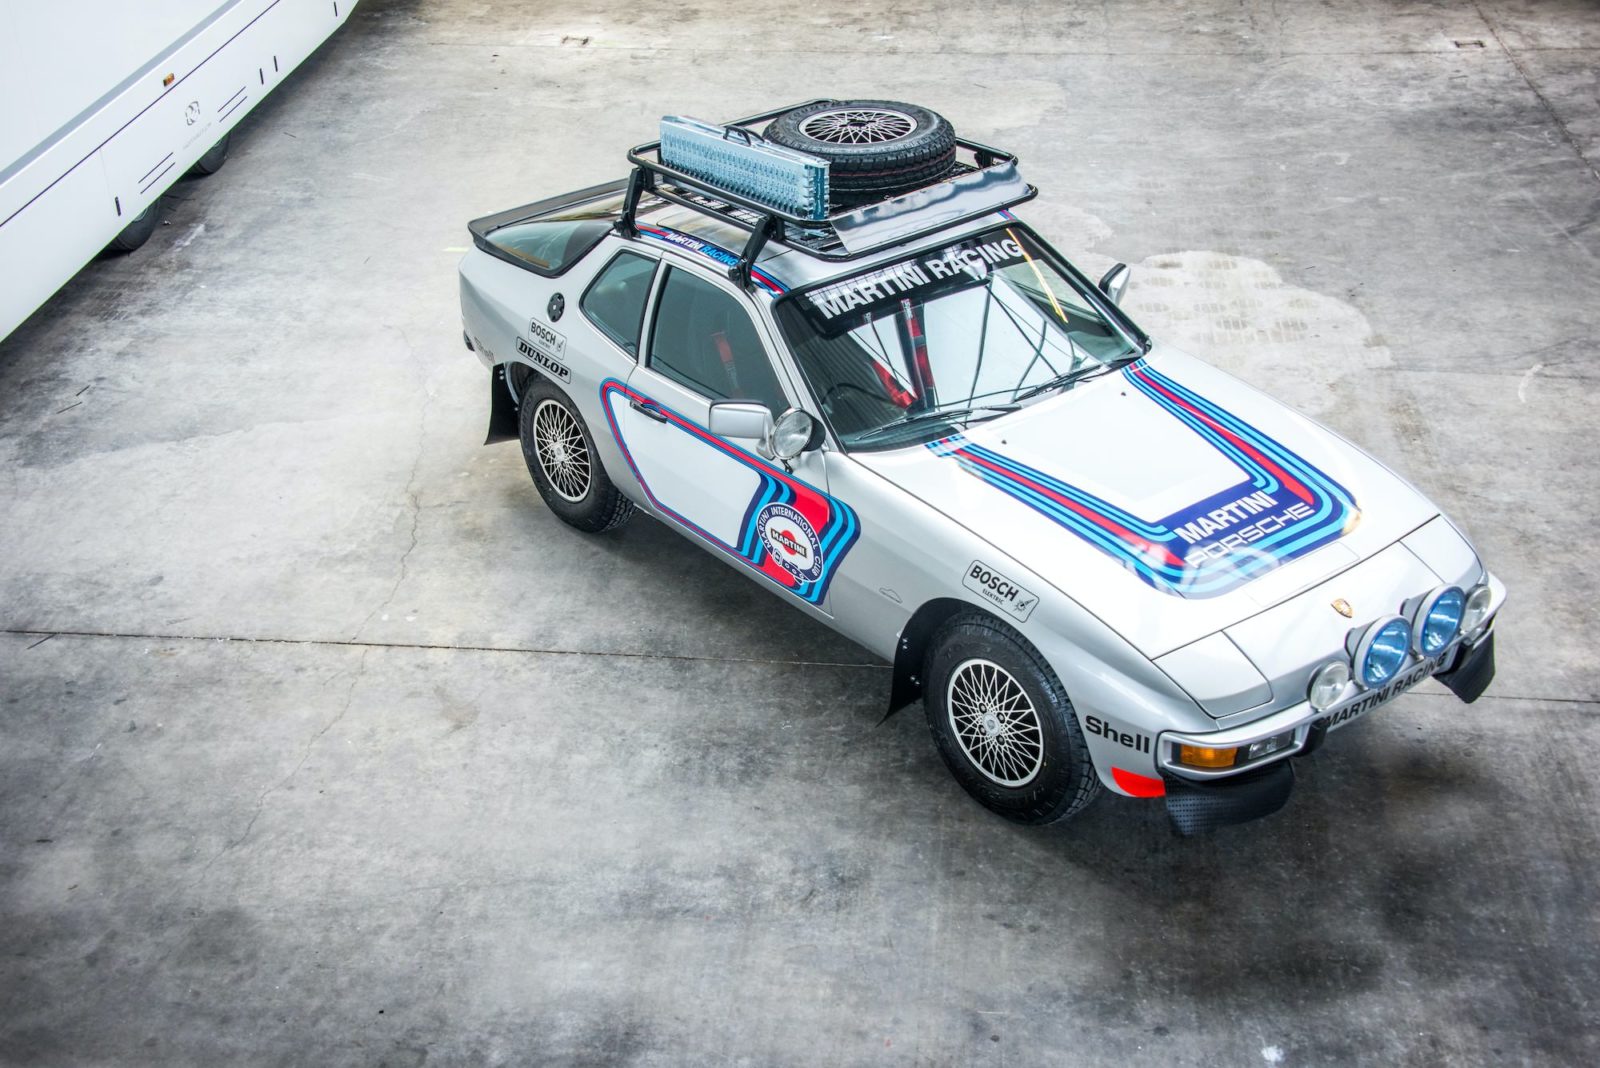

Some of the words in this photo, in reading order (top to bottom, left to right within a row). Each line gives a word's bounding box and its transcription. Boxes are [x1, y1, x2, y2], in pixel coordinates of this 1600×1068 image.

[665, 233, 705, 249] MARTINI
[701, 244, 739, 266] RACING
[814, 265, 931, 320] MARTINI
[925, 238, 1024, 280] RACING
[530, 321, 557, 346] BOSCH
[519, 341, 569, 378] DUNLOP
[771, 506, 818, 550] INTERNATIONAL
[1173, 490, 1279, 545] MARTINI
[1184, 502, 1316, 569] PORSCHE
[771, 529, 807, 557] MARTINI
[970, 564, 1020, 602] BOSCH
[1325, 685, 1391, 727] MARTINI
[1391, 651, 1448, 697] RACING
[1085, 714, 1150, 755] Shell
